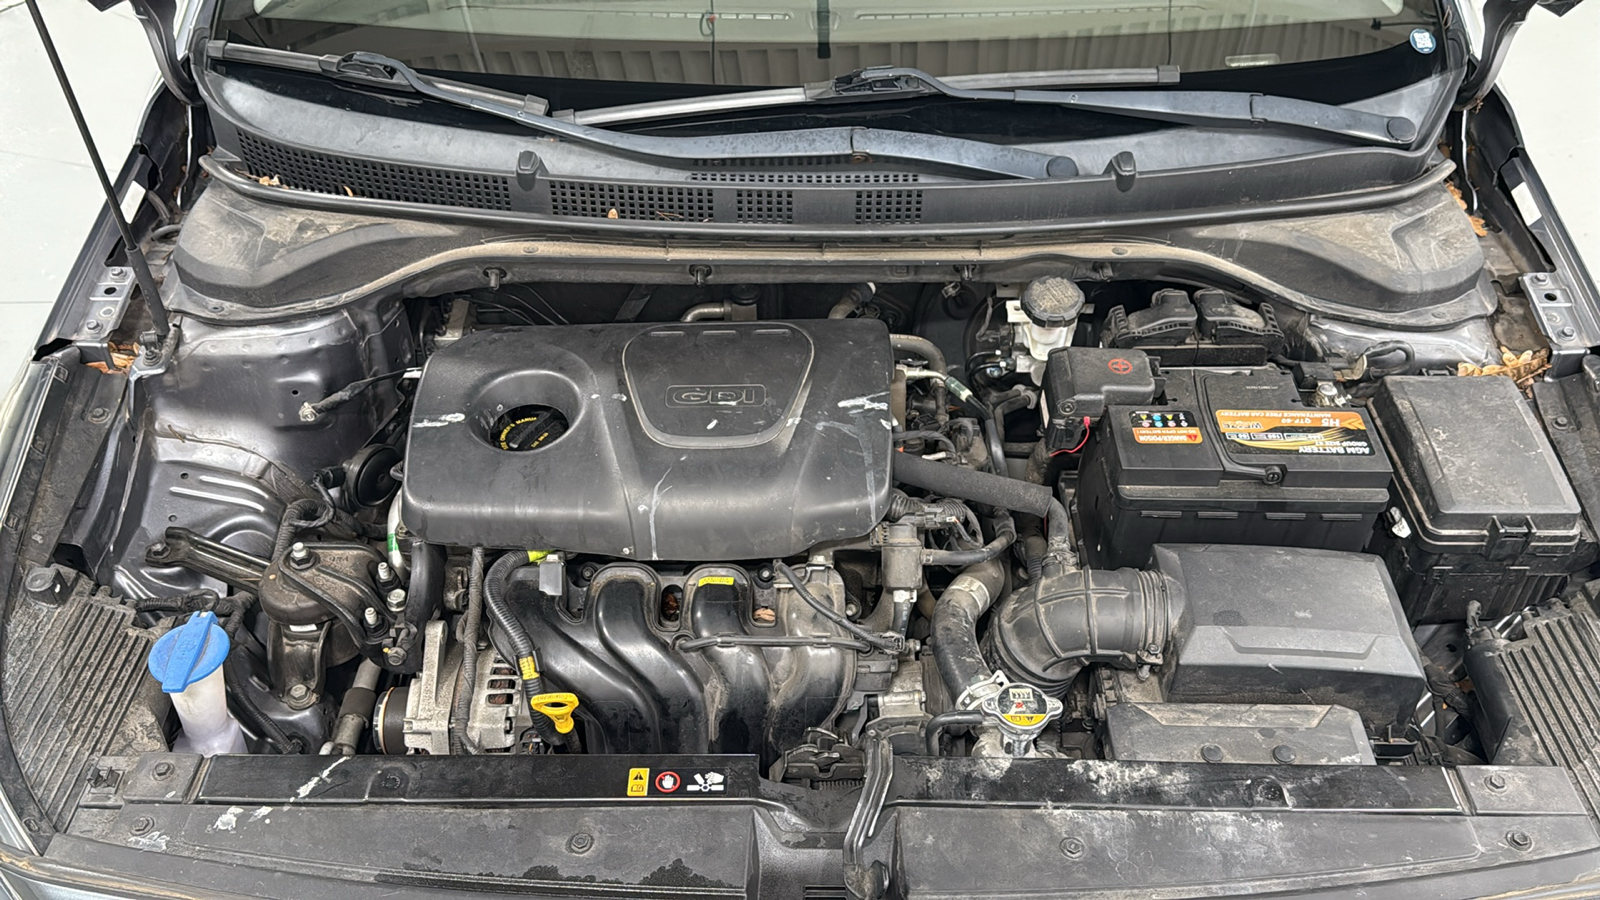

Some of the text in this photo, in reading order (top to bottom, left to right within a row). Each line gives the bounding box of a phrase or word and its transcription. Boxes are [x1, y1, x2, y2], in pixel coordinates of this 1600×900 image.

[673, 388, 754, 405] GDI
[1321, 418, 1340, 427] H5
[1299, 446, 1346, 454] BATTERY
